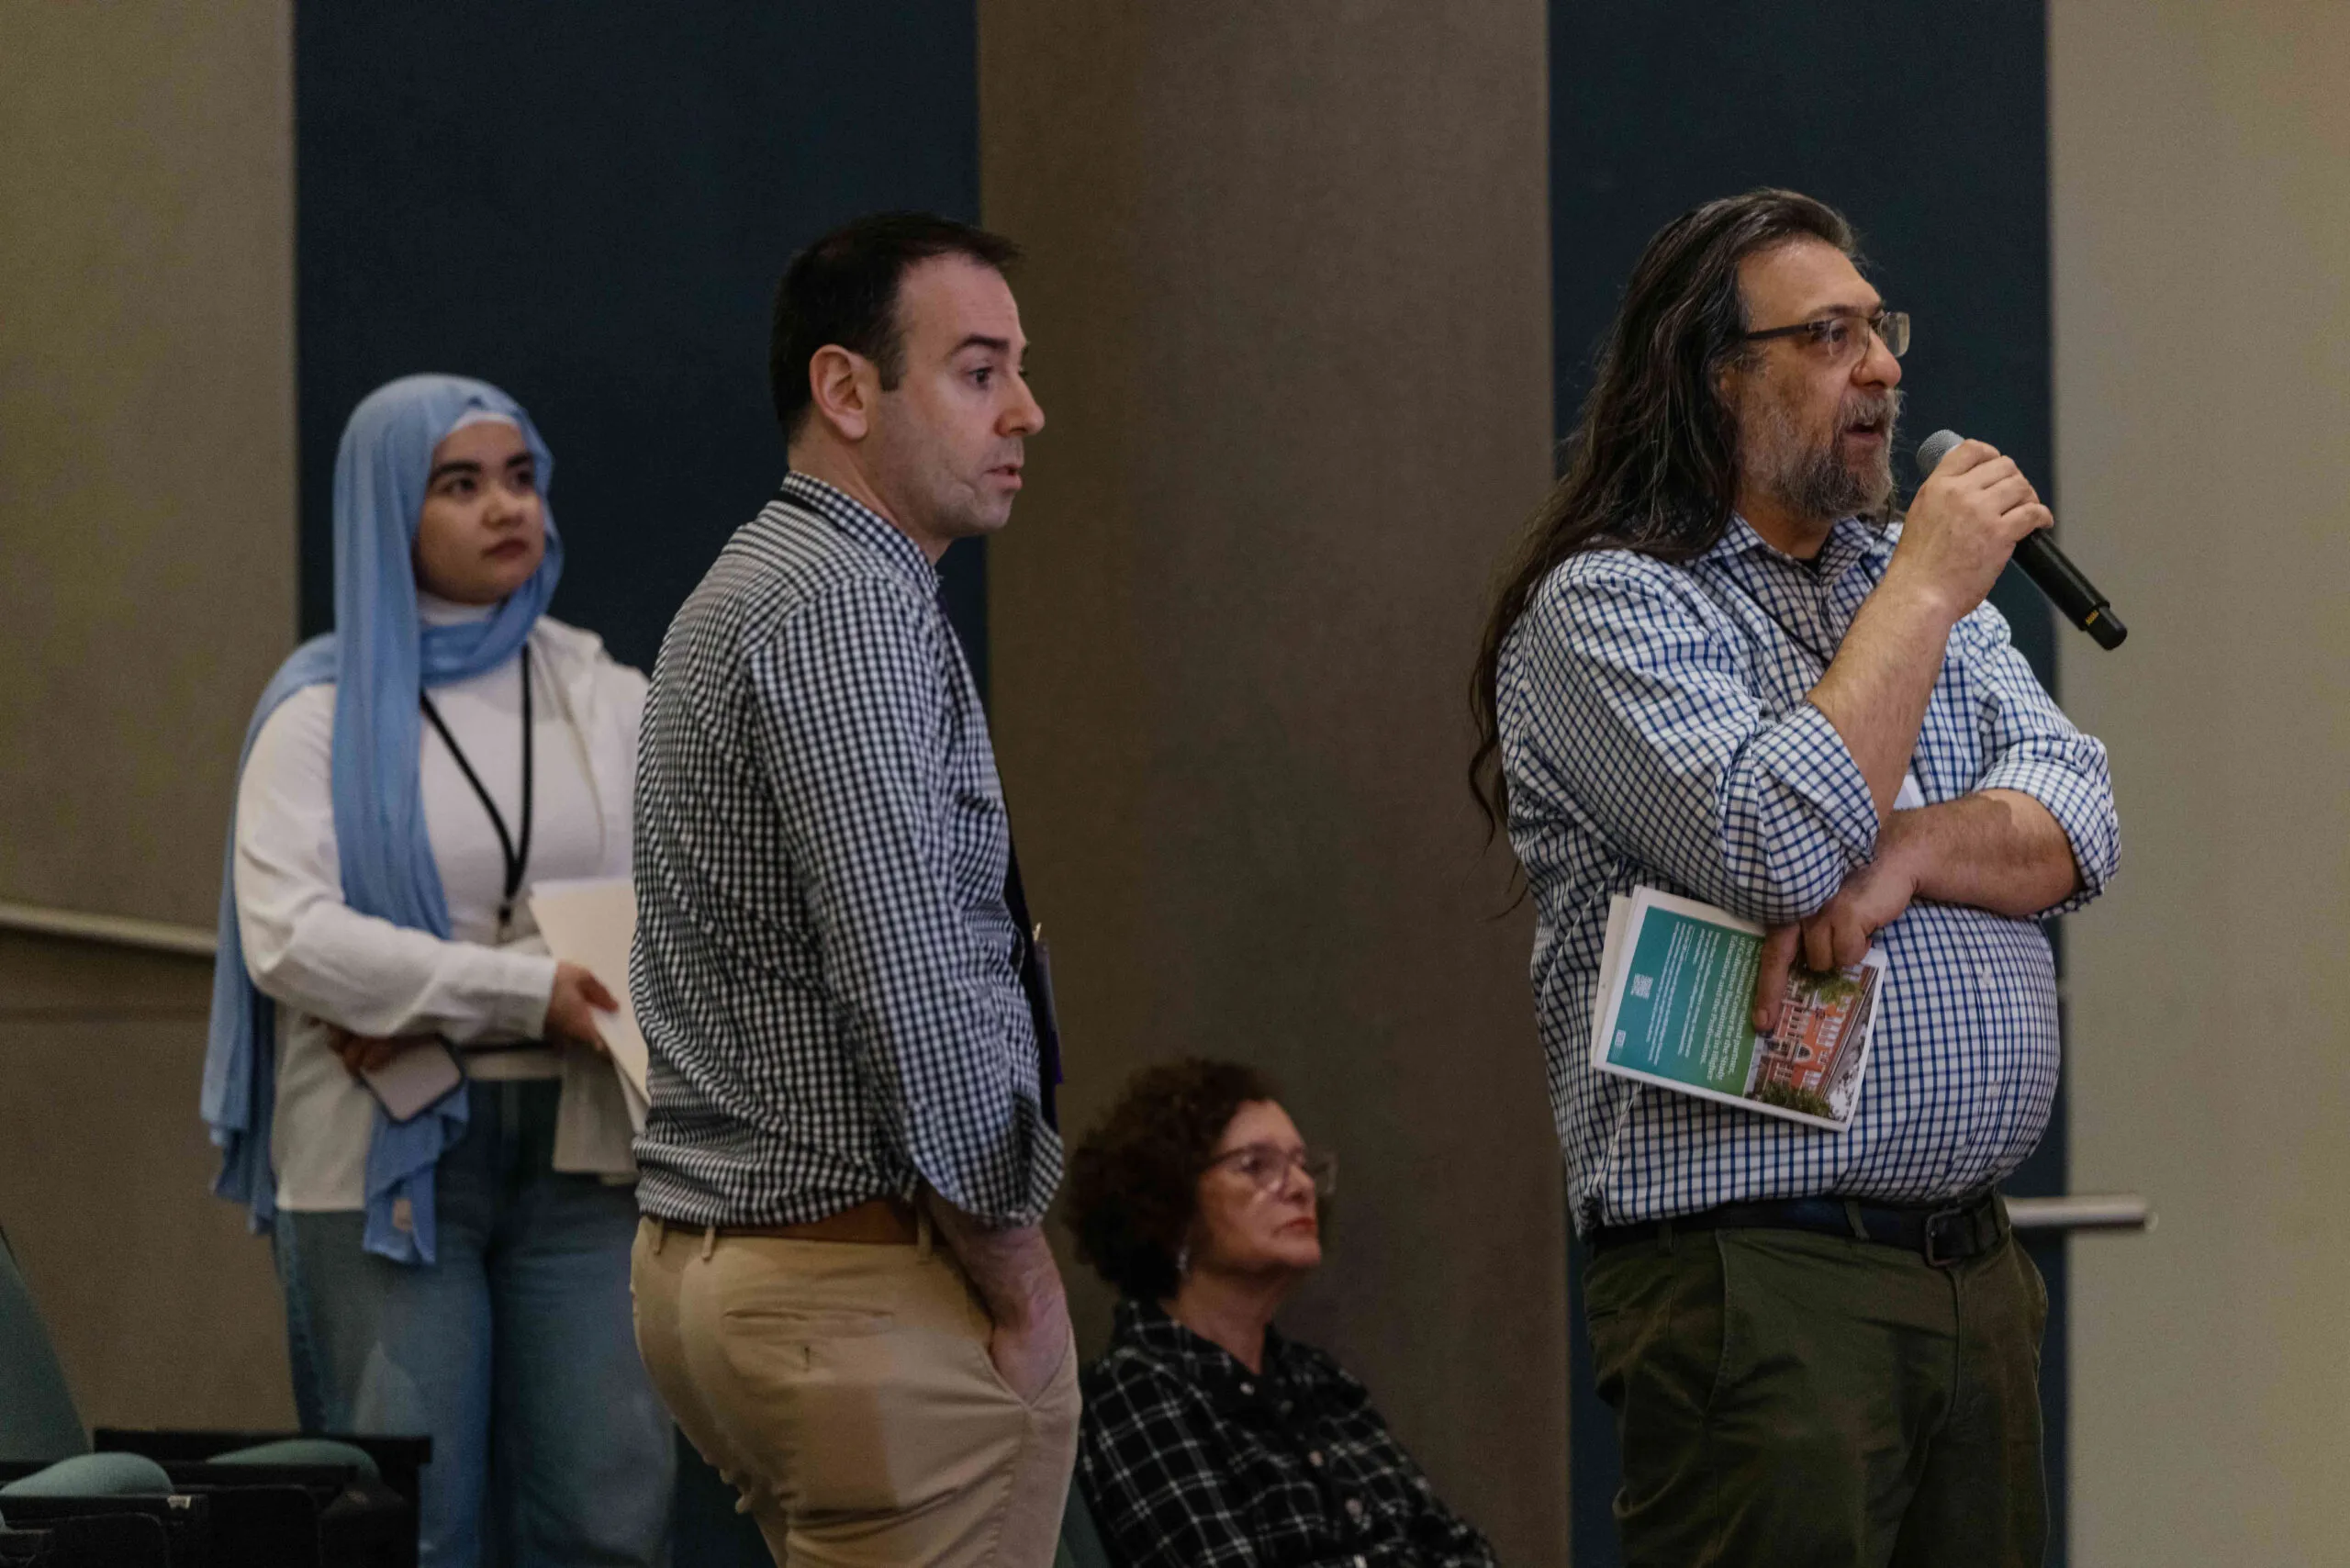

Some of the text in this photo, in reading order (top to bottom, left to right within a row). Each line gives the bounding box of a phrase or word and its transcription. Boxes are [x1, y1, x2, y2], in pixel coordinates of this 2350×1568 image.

[1720, 934, 1738, 979] Education
[1736, 958, 1751, 995] National
[1729, 994, 1741, 1025] Center
